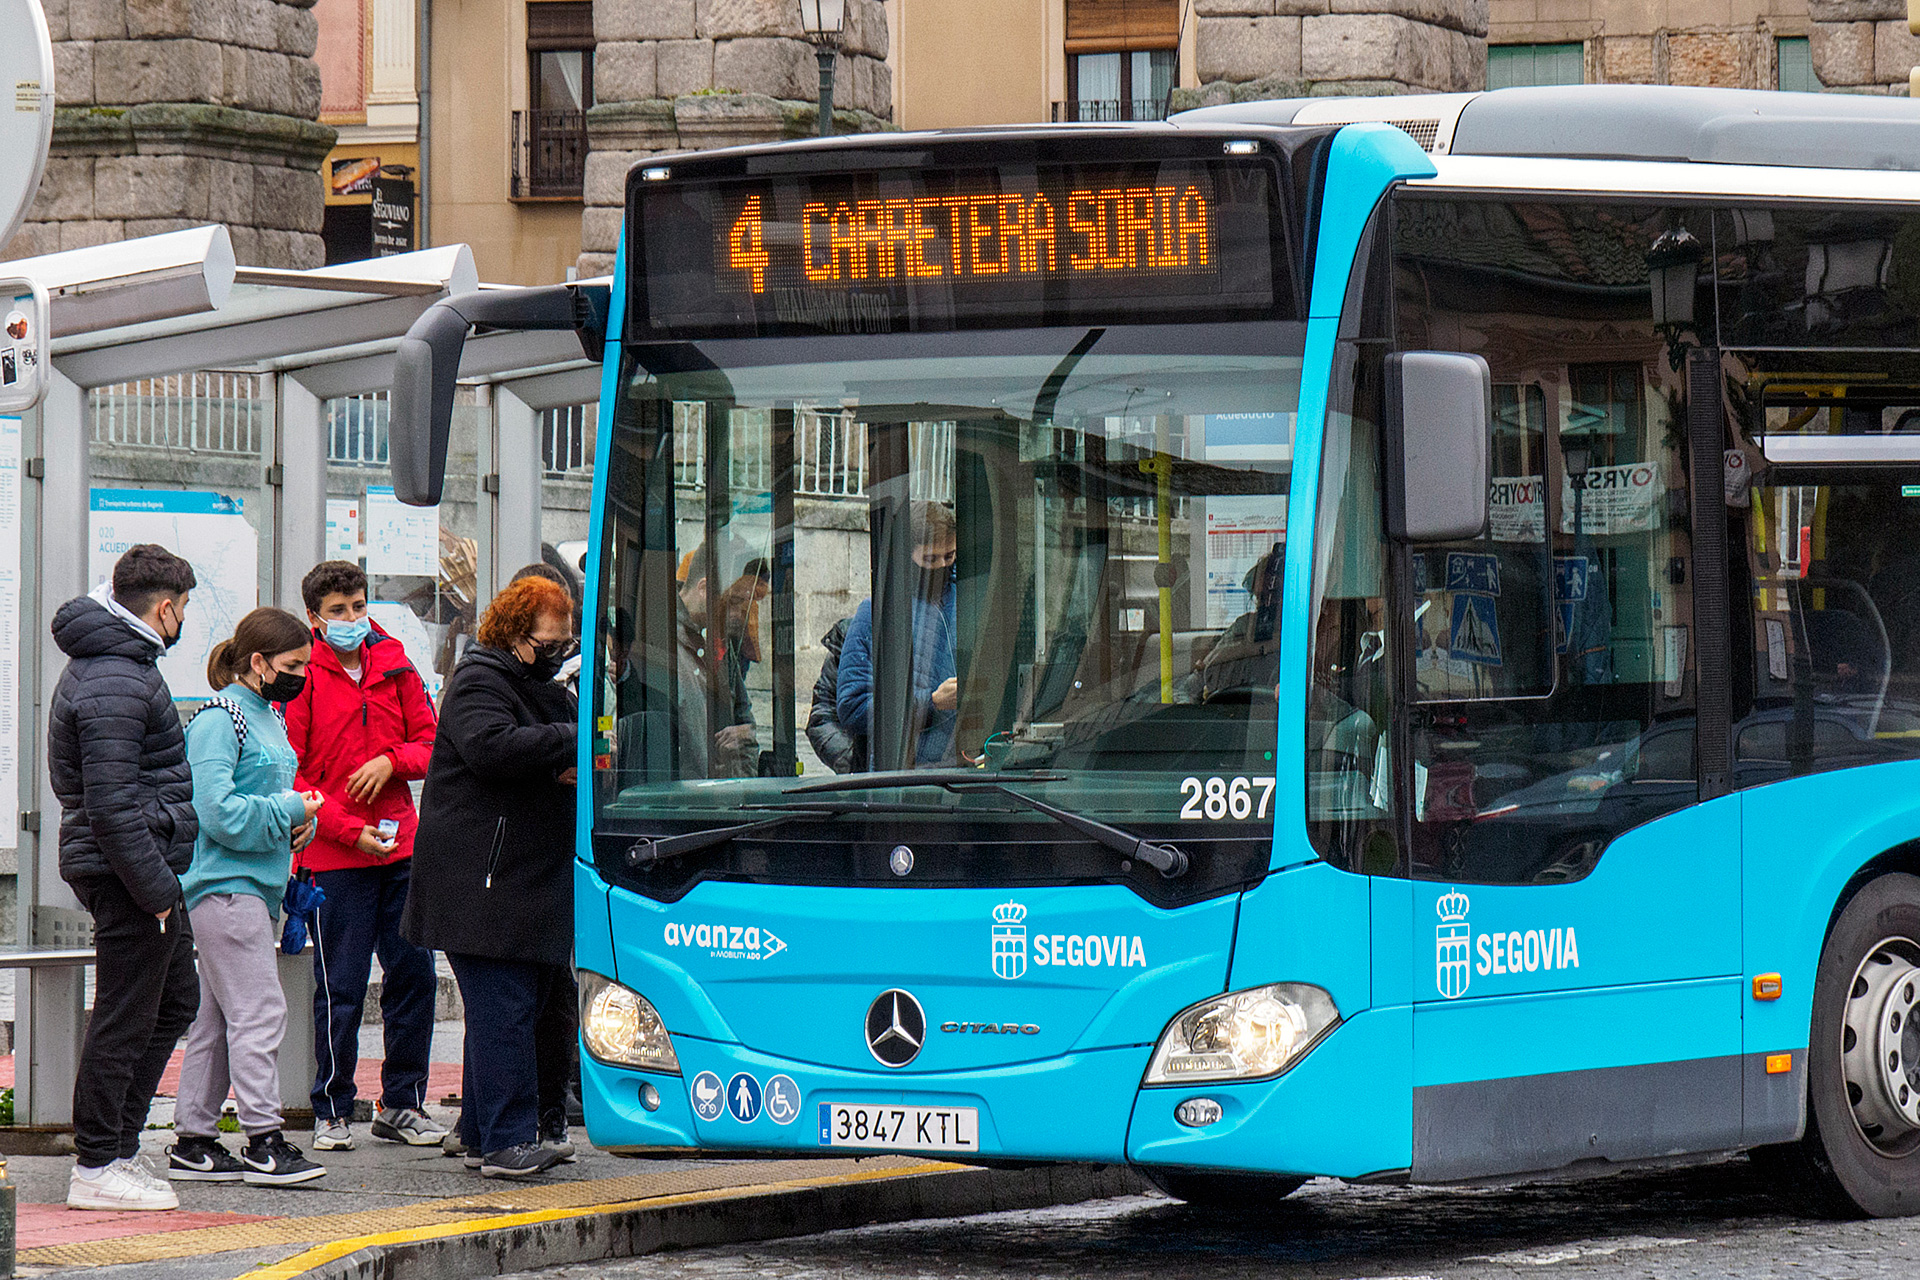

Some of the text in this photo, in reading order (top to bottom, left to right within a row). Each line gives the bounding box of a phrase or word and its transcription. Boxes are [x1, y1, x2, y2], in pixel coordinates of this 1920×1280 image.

[372, 199, 410, 222] SEGOVIANO
[729, 186, 1208, 293] 4 CARRETERA SORIA
[98, 526, 115, 539] 020
[1180, 776, 1276, 820] 2867
[664, 922, 761, 950] avanza
[1033, 934, 1147, 967] SEGOVIA
[716, 951, 746, 959] MOBILITY
[747, 952, 761, 960] ADO
[1475, 927, 1580, 976] SEGOVIA
[940, 1021, 1041, 1035] CITARO
[822, 1109, 971, 1145] E 3847 KTL
